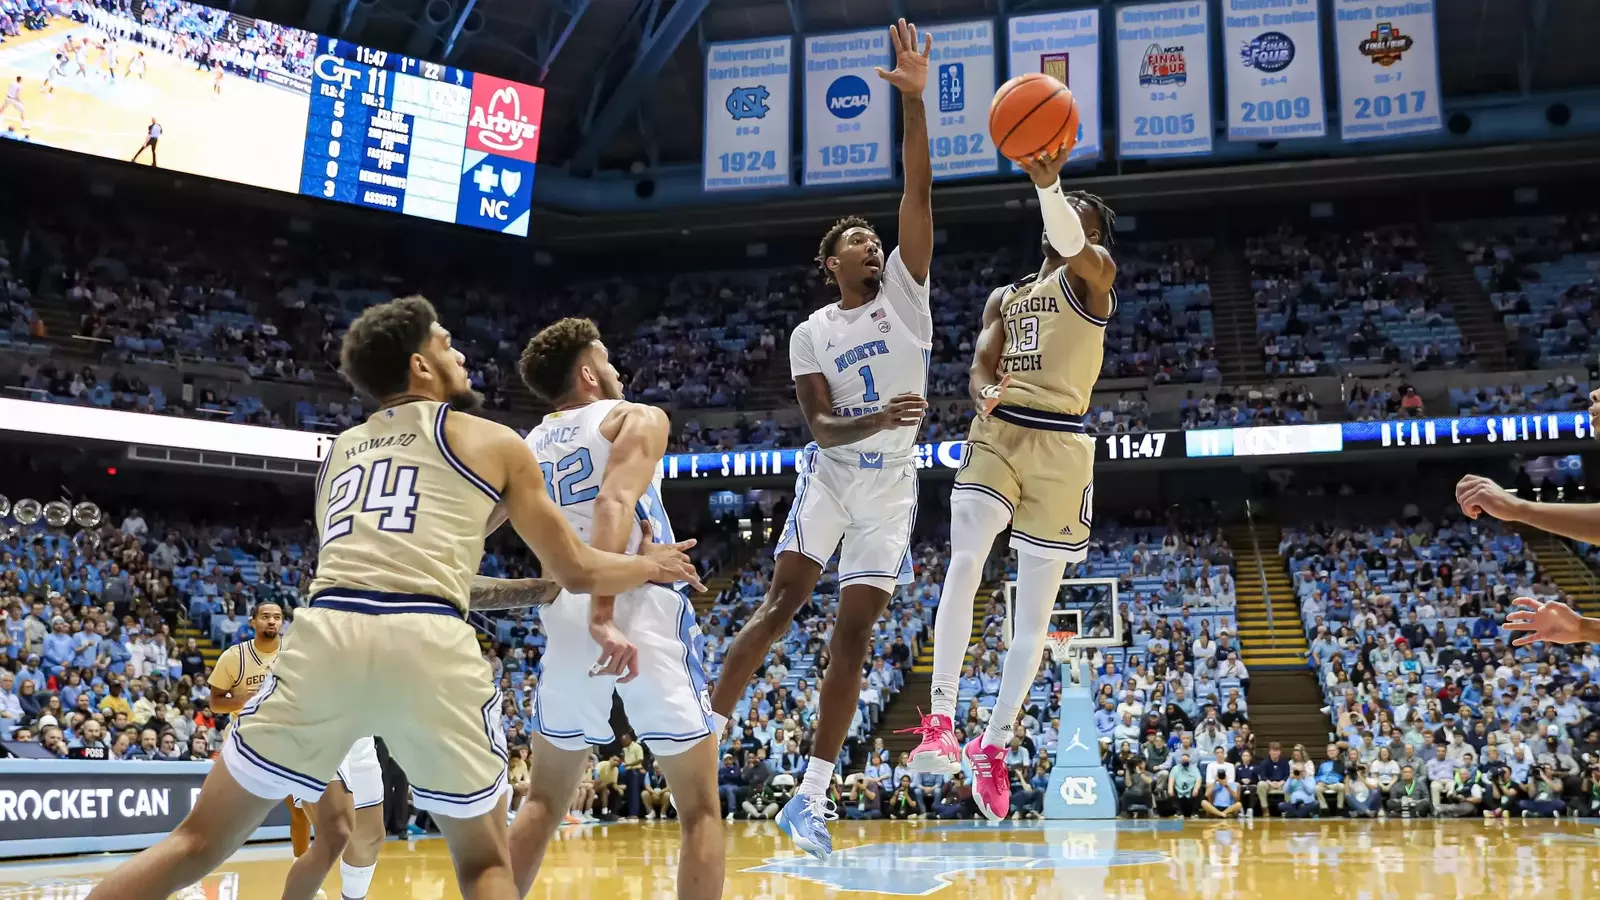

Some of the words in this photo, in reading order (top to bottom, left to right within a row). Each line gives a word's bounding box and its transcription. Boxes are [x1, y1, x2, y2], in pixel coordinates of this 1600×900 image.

[356, 46, 388, 67] 11:47
[1148, 54, 1184, 65] FINAL
[368, 67, 387, 96] 11
[424, 62, 439, 80] 22
[333, 100, 345, 118] 5
[830, 94, 869, 109] NCAA
[1241, 97, 1310, 122] 2009
[1354, 90, 1426, 119] 2017
[331, 120, 343, 138] 0
[469, 106, 538, 141] Arby's
[1134, 113, 1195, 136] 2005
[329, 141, 340, 158] 0
[818, 142, 879, 166] 1957
[929, 132, 984, 159] 1982
[326, 161, 338, 178] 0
[719, 150, 777, 173] 1924
[323, 180, 335, 197] 3
[479, 197, 509, 220] NC
[1003, 297, 1060, 318] ORGIA
[1007, 316, 1039, 354] 13
[834, 340, 889, 373] NORTH
[1003, 355, 1042, 372] TECH
[858, 365, 879, 403] 1
[535, 426, 580, 454] NANCE
[1381, 420, 1436, 447] DEAN
[1451, 419, 1471, 444] E.
[1486, 415, 1559, 443] SMITH
[344, 433, 417, 460] HOWARD
[1106, 433, 1166, 460] 11:47
[691, 455, 708, 477] E.
[721, 451, 781, 477] SMITH
[320, 457, 420, 550] 24
[709, 494, 743, 505] SIDE
[246, 674, 267, 686] GEO
[85, 748, 104, 758] POSS
[0, 788, 114, 821] ROCKET
[118, 788, 169, 818] CAN
